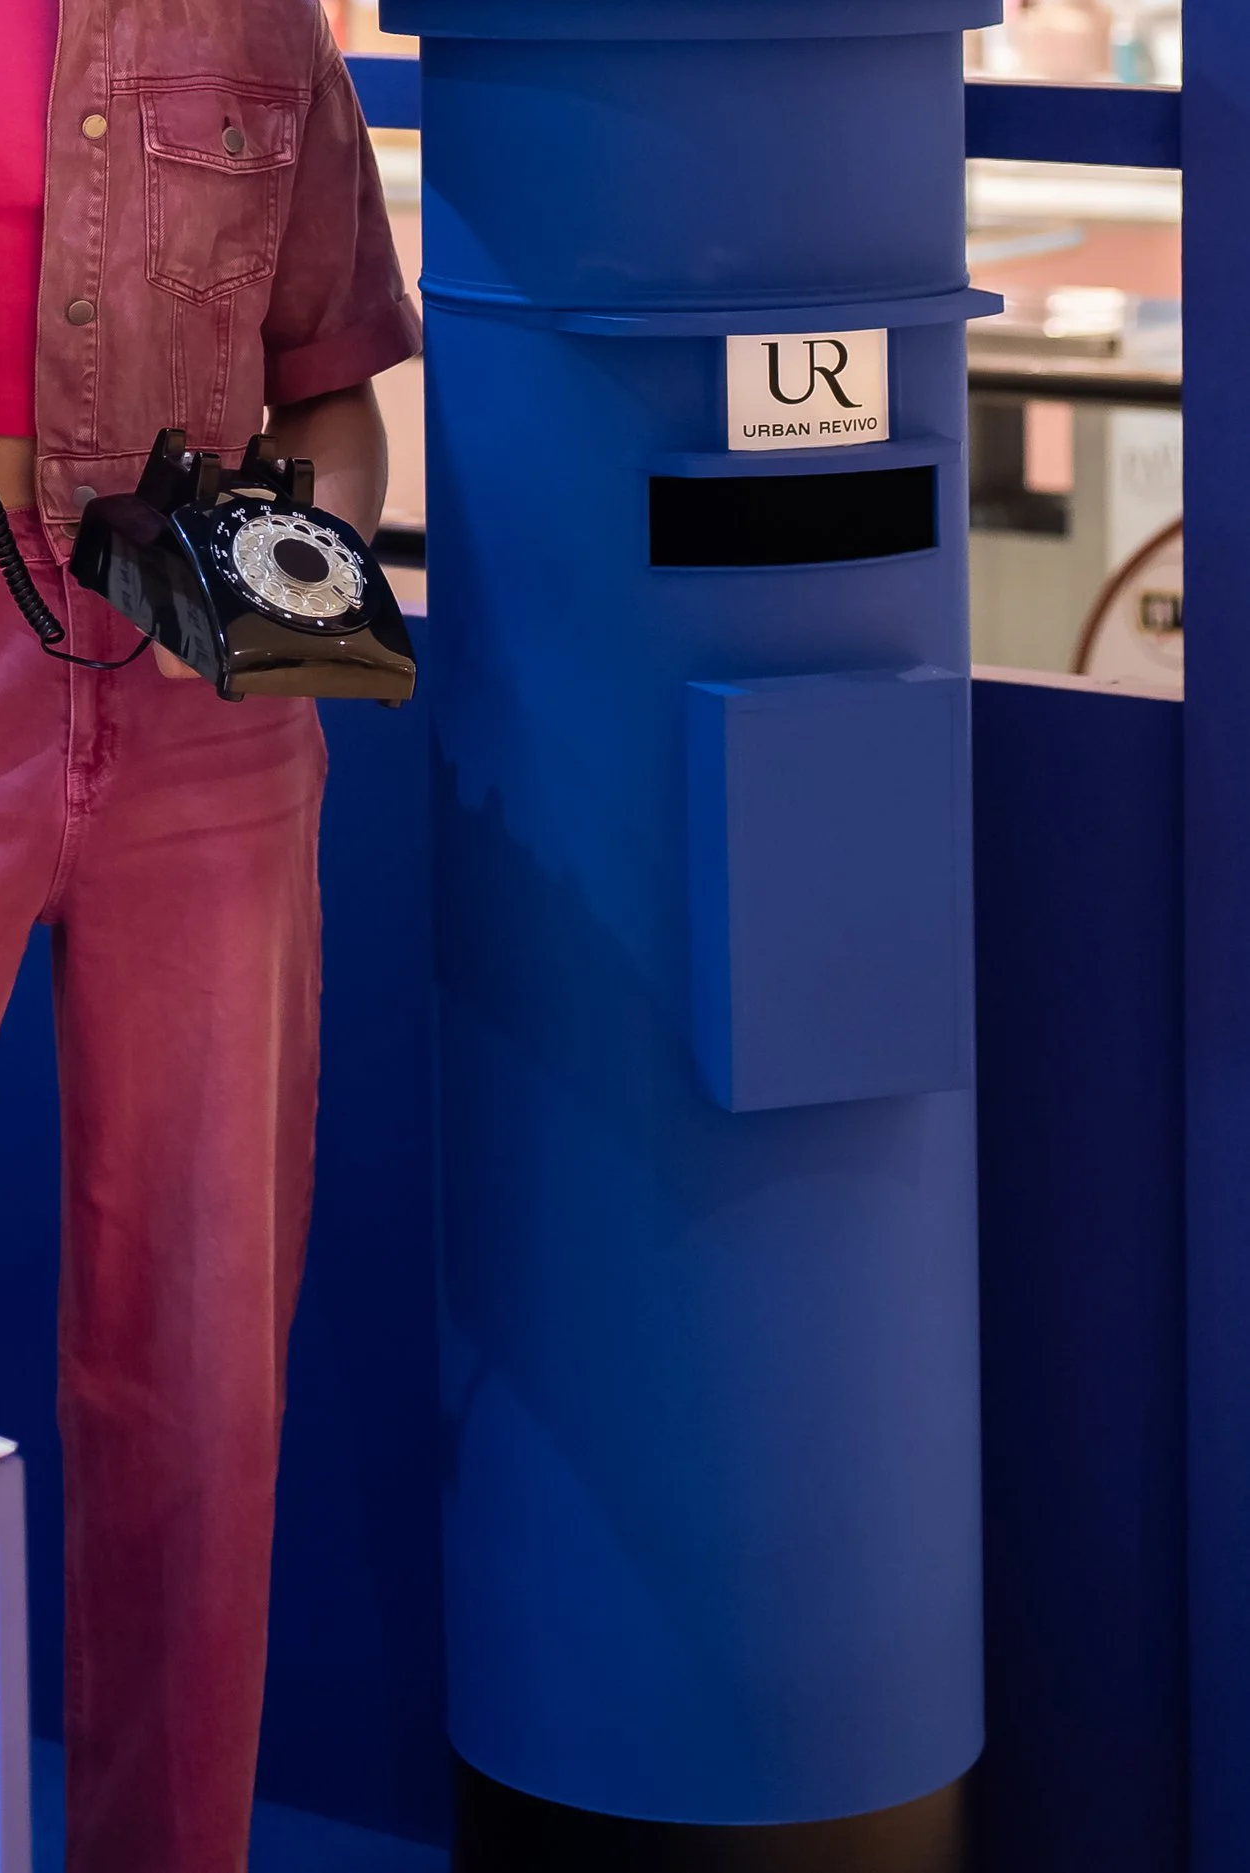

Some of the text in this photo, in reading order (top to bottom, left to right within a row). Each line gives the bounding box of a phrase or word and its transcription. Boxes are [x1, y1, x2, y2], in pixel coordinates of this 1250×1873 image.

[760, 338, 863, 409] UR
[742, 416, 879, 439] URBAN REVIVO
